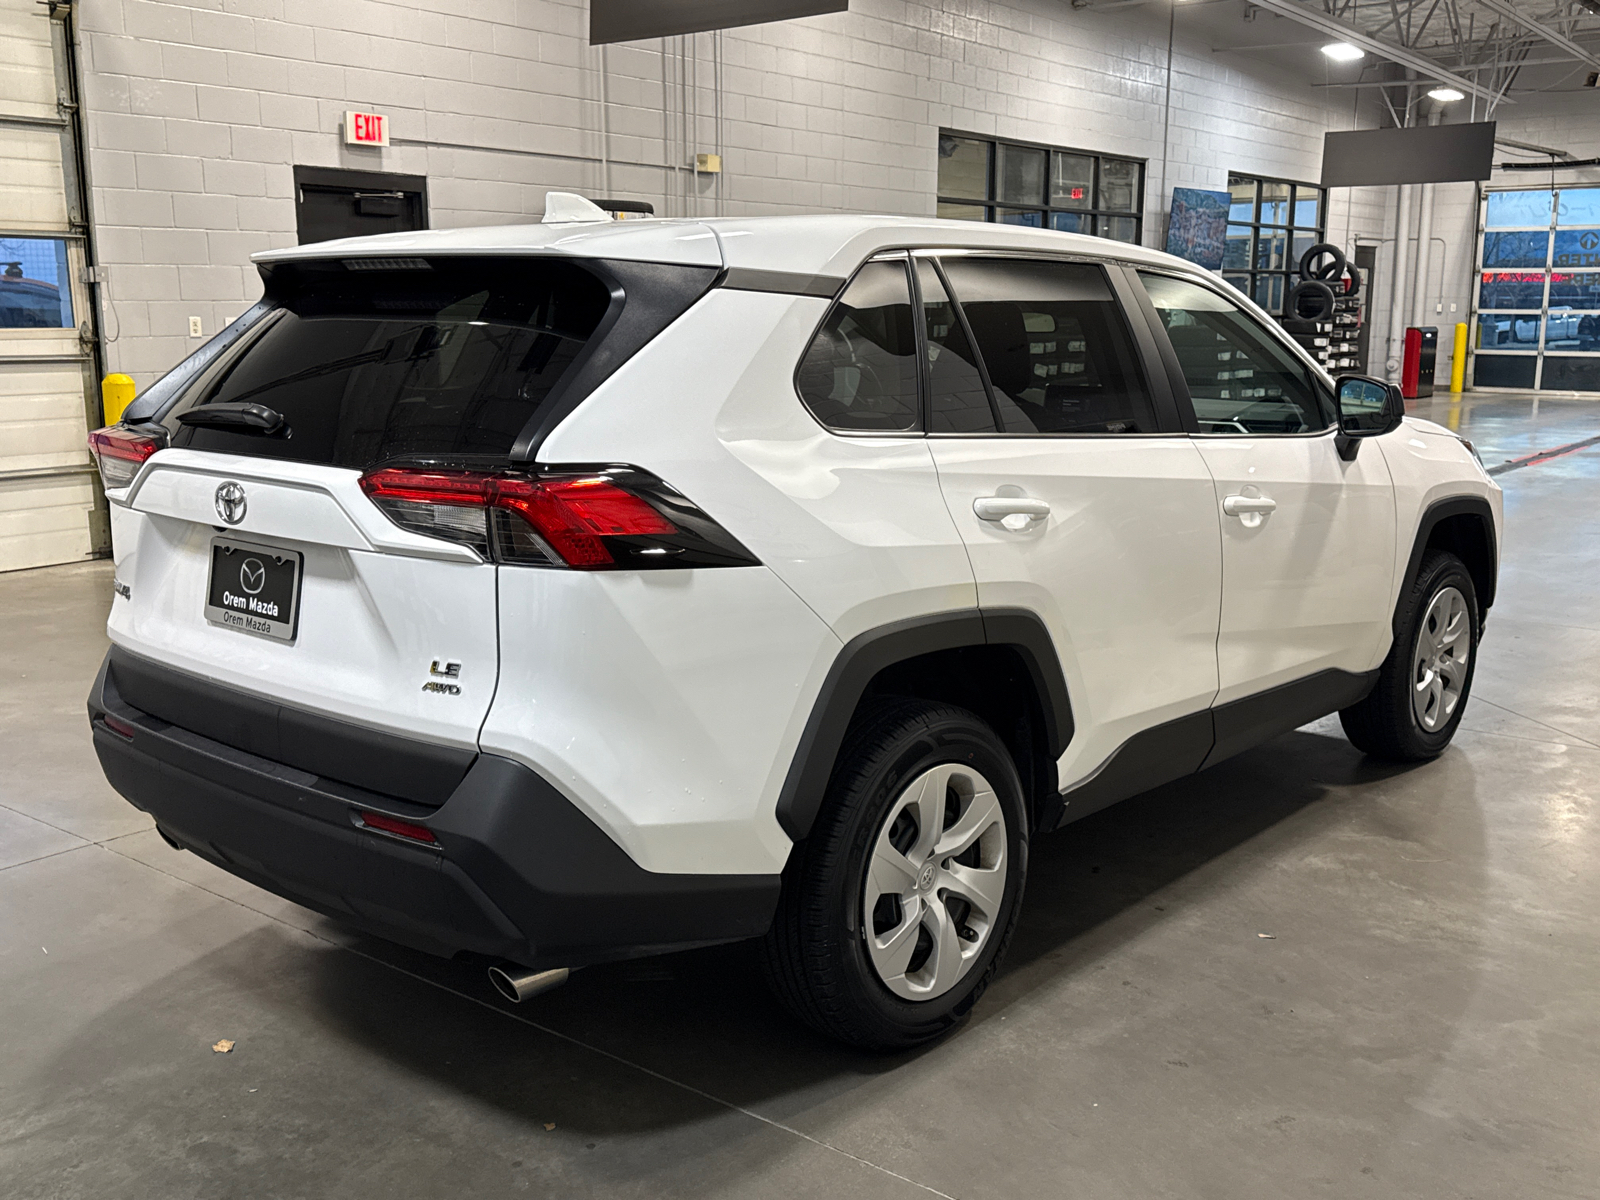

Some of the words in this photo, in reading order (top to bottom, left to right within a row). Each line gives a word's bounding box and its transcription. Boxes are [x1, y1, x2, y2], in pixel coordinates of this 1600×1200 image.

[354, 113, 383, 144] EXIT
[223, 591, 246, 609] Orem
[249, 596, 279, 617] Mazda
[223, 611, 244, 627] Orem
[245, 616, 271, 633] Mazda
[430, 659, 461, 679] LE
[422, 682, 461, 696] AWD
